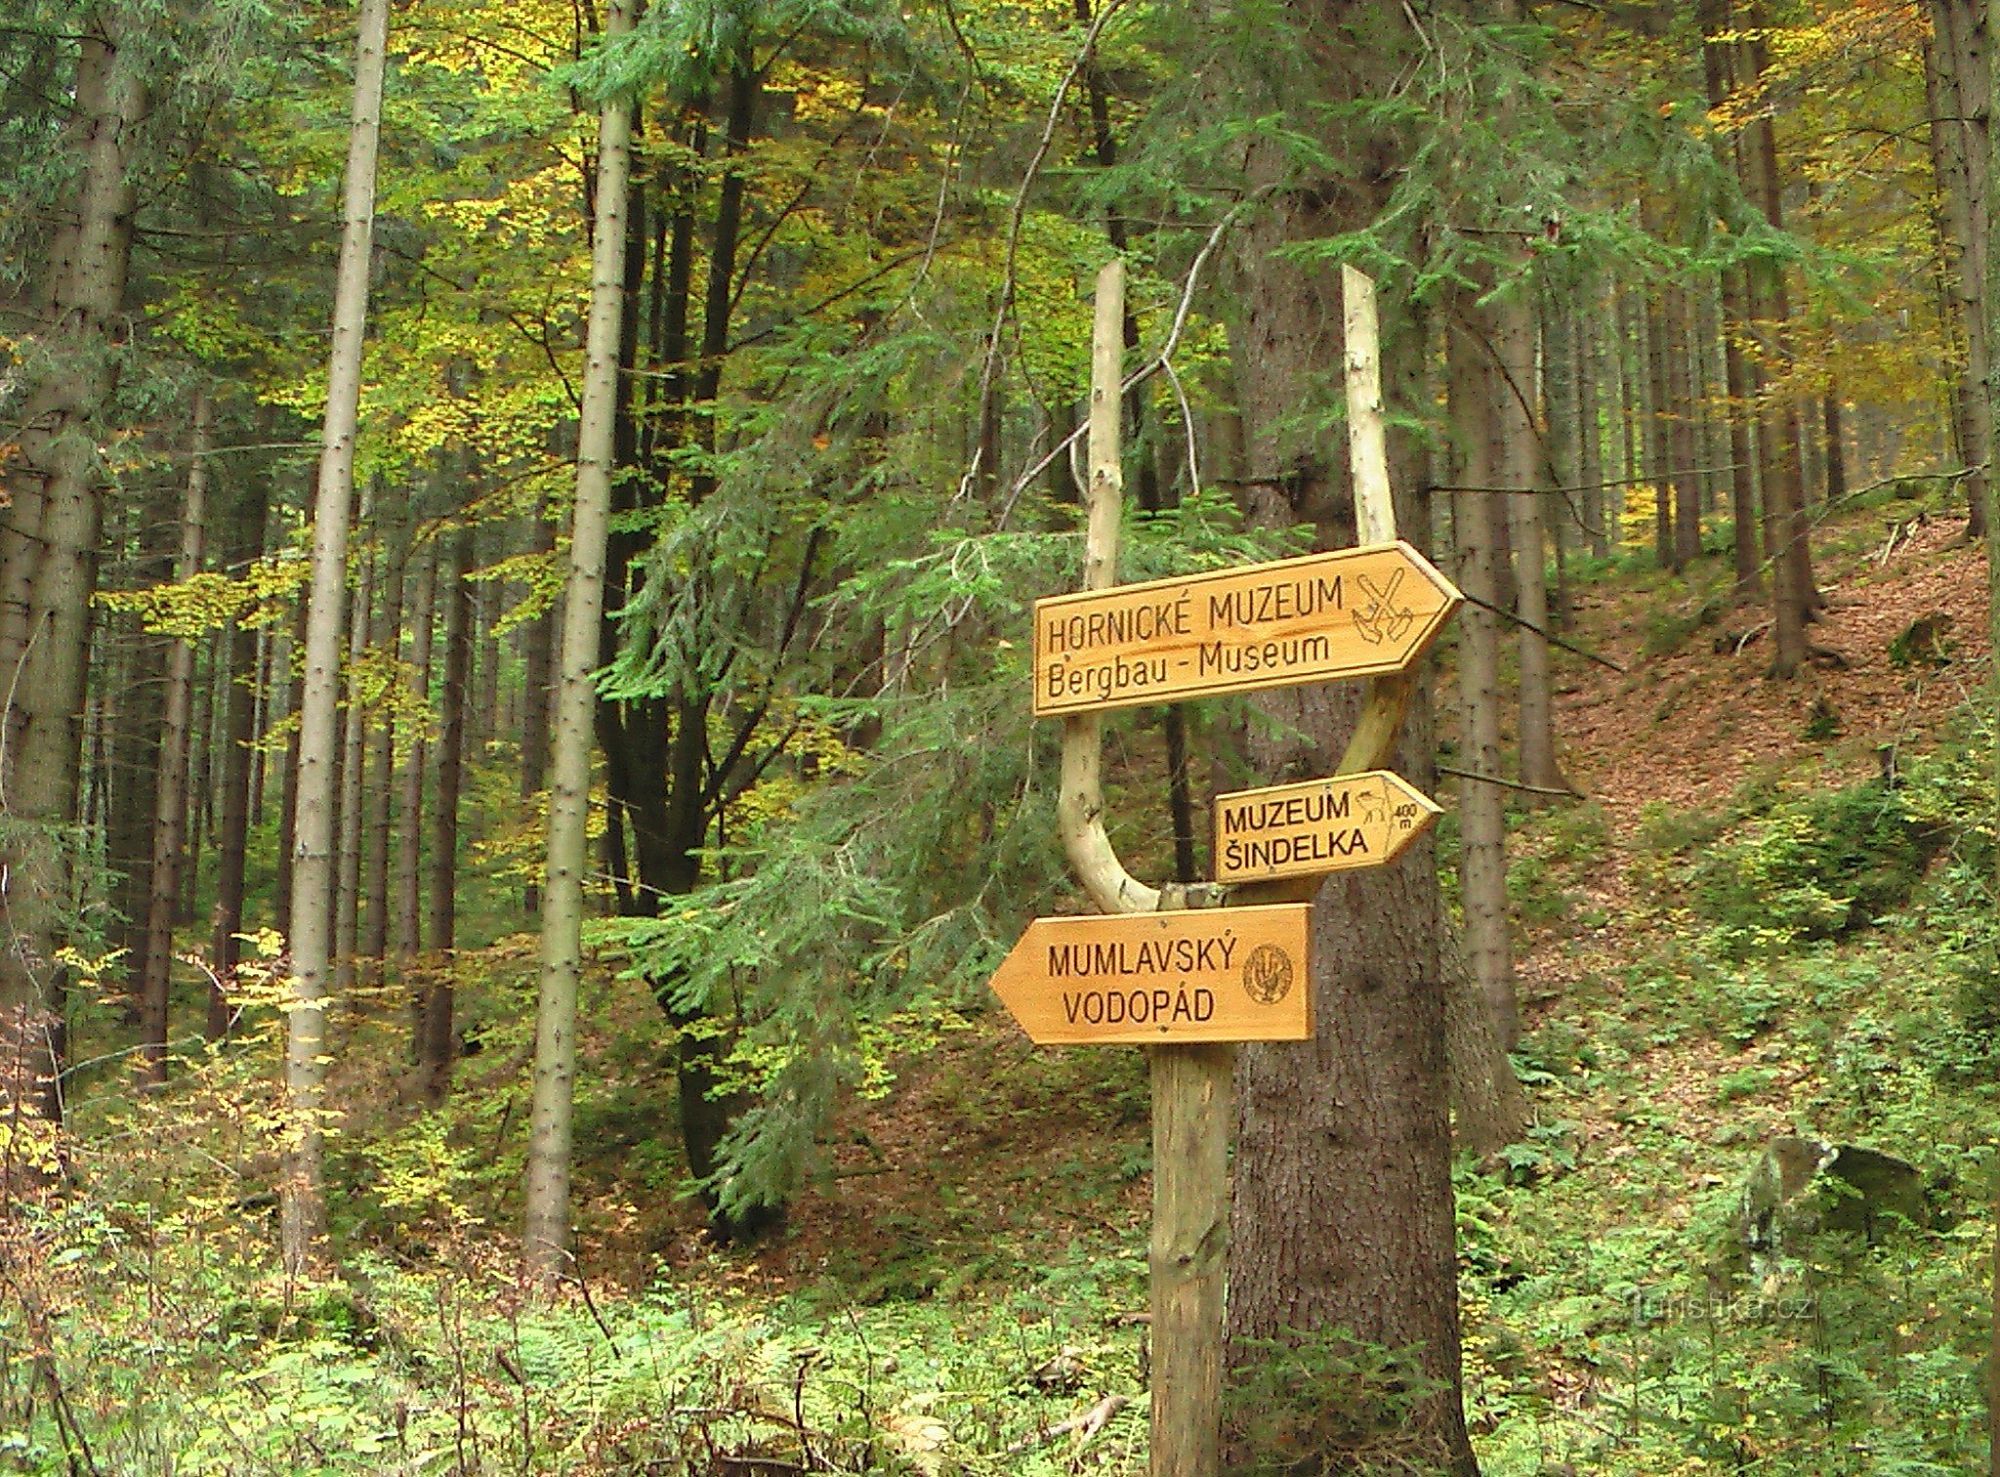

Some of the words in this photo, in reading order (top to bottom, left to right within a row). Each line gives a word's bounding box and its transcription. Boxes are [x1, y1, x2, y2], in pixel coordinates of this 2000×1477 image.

[1048, 588, 1191, 652] HORNICKÉ
[1209, 575, 1343, 629] MUZEUM
[1048, 656, 1167, 699] Bergbau
[1199, 634, 1330, 677] Museum
[1224, 791, 1350, 834] MUZEUM
[1394, 803, 1418, 817] 400
[1225, 828, 1369, 871] ŠINDELKA
[1049, 929, 1237, 976] MUMLAVSKÝ
[1063, 980, 1215, 1024] VODOPÁD
